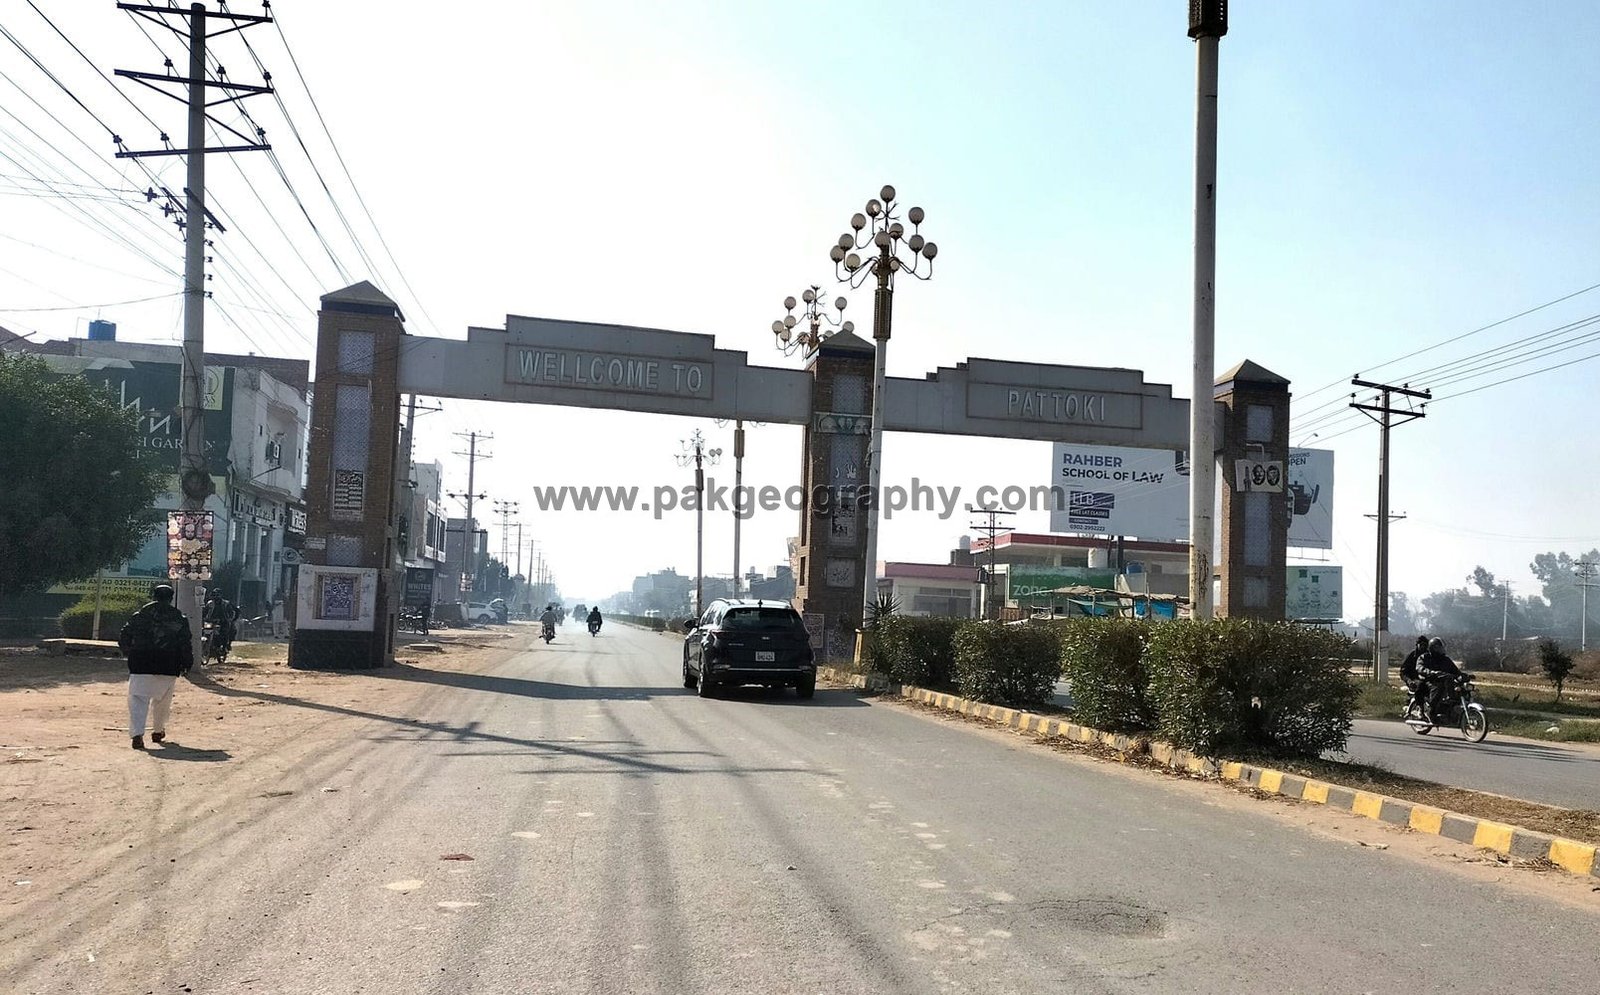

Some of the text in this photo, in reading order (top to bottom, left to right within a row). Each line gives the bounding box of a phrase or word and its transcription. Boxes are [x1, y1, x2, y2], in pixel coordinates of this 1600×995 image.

[518, 350, 703, 393] WELLCOME TO
[1007, 389, 1106, 422] PATTOKI
[1063, 453, 1122, 468] RAHBER
[1288, 457, 1307, 466] PEN
[1062, 467, 1164, 484] SCHOOL OF LAW
